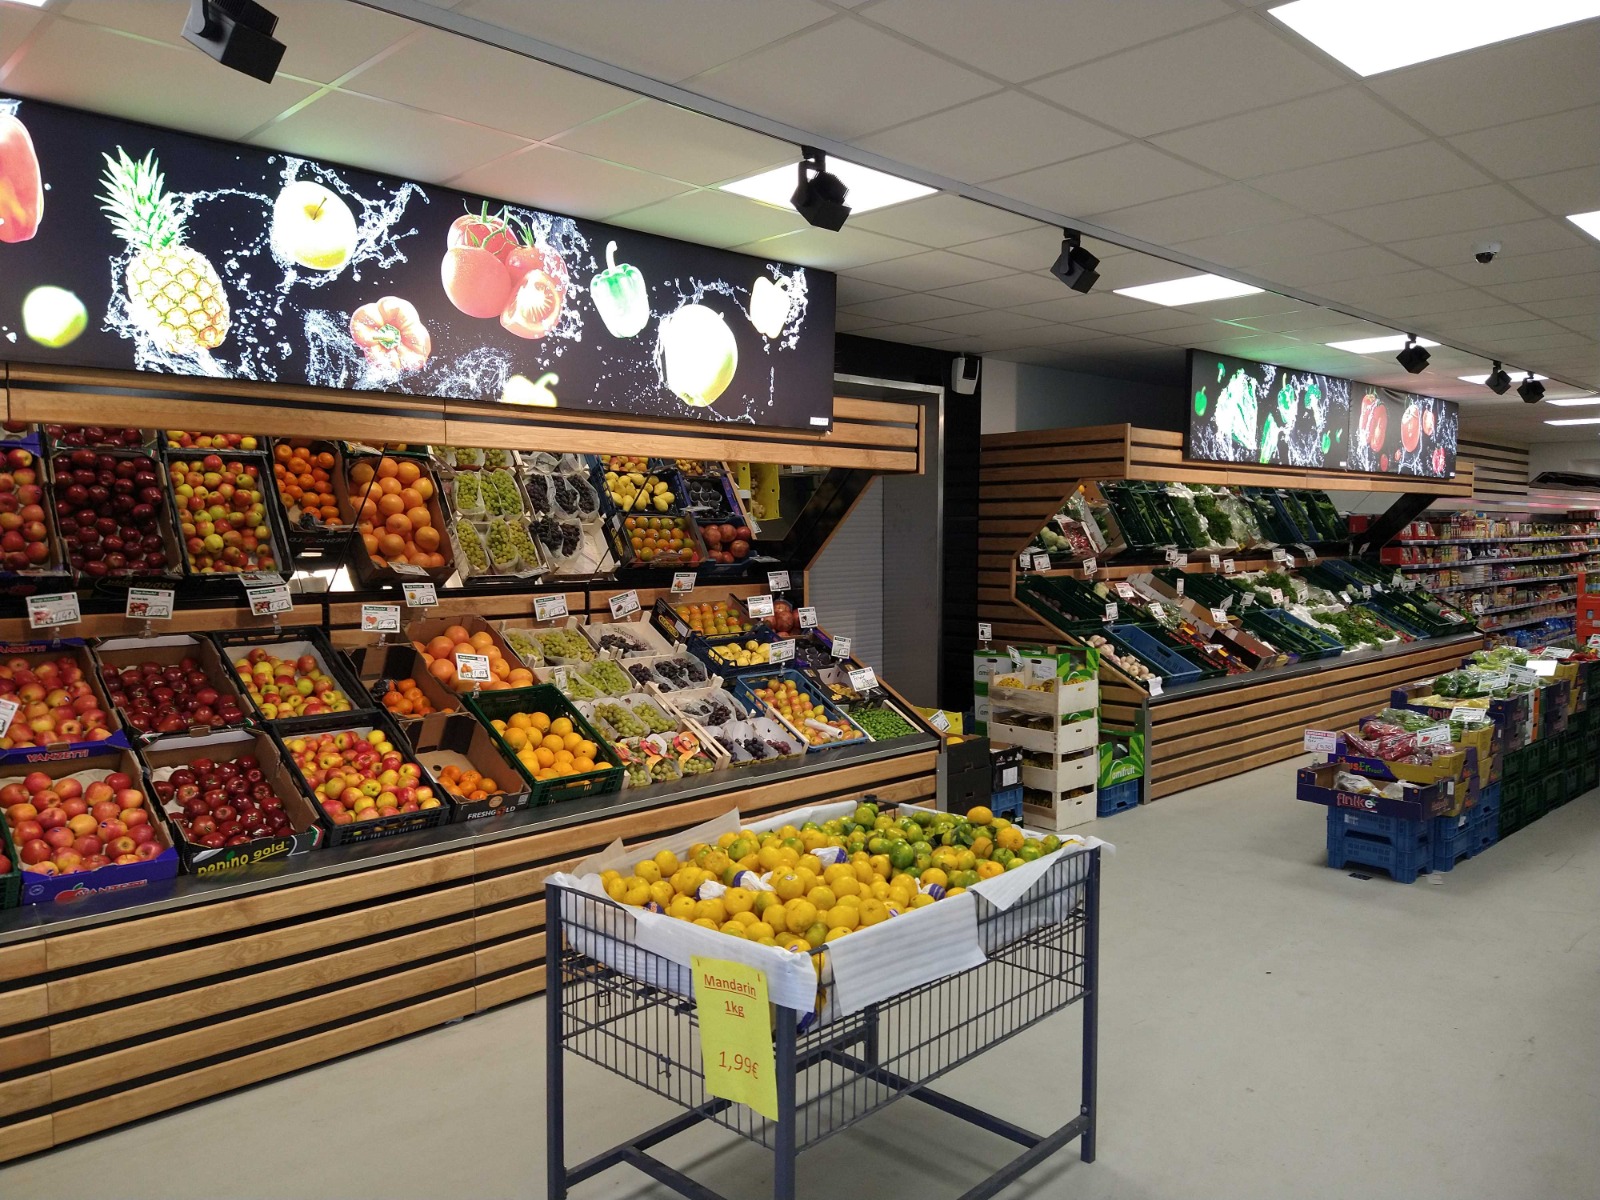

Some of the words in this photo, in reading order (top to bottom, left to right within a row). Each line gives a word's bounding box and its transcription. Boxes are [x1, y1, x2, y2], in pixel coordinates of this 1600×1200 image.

[27, 749, 89, 762] VANZETTI
[253, 841, 285, 859] gold
[704, 974, 757, 997] Mandarin
[725, 1000, 745, 1017] 1kg
[718, 1051, 759, 1079] 1,99€
